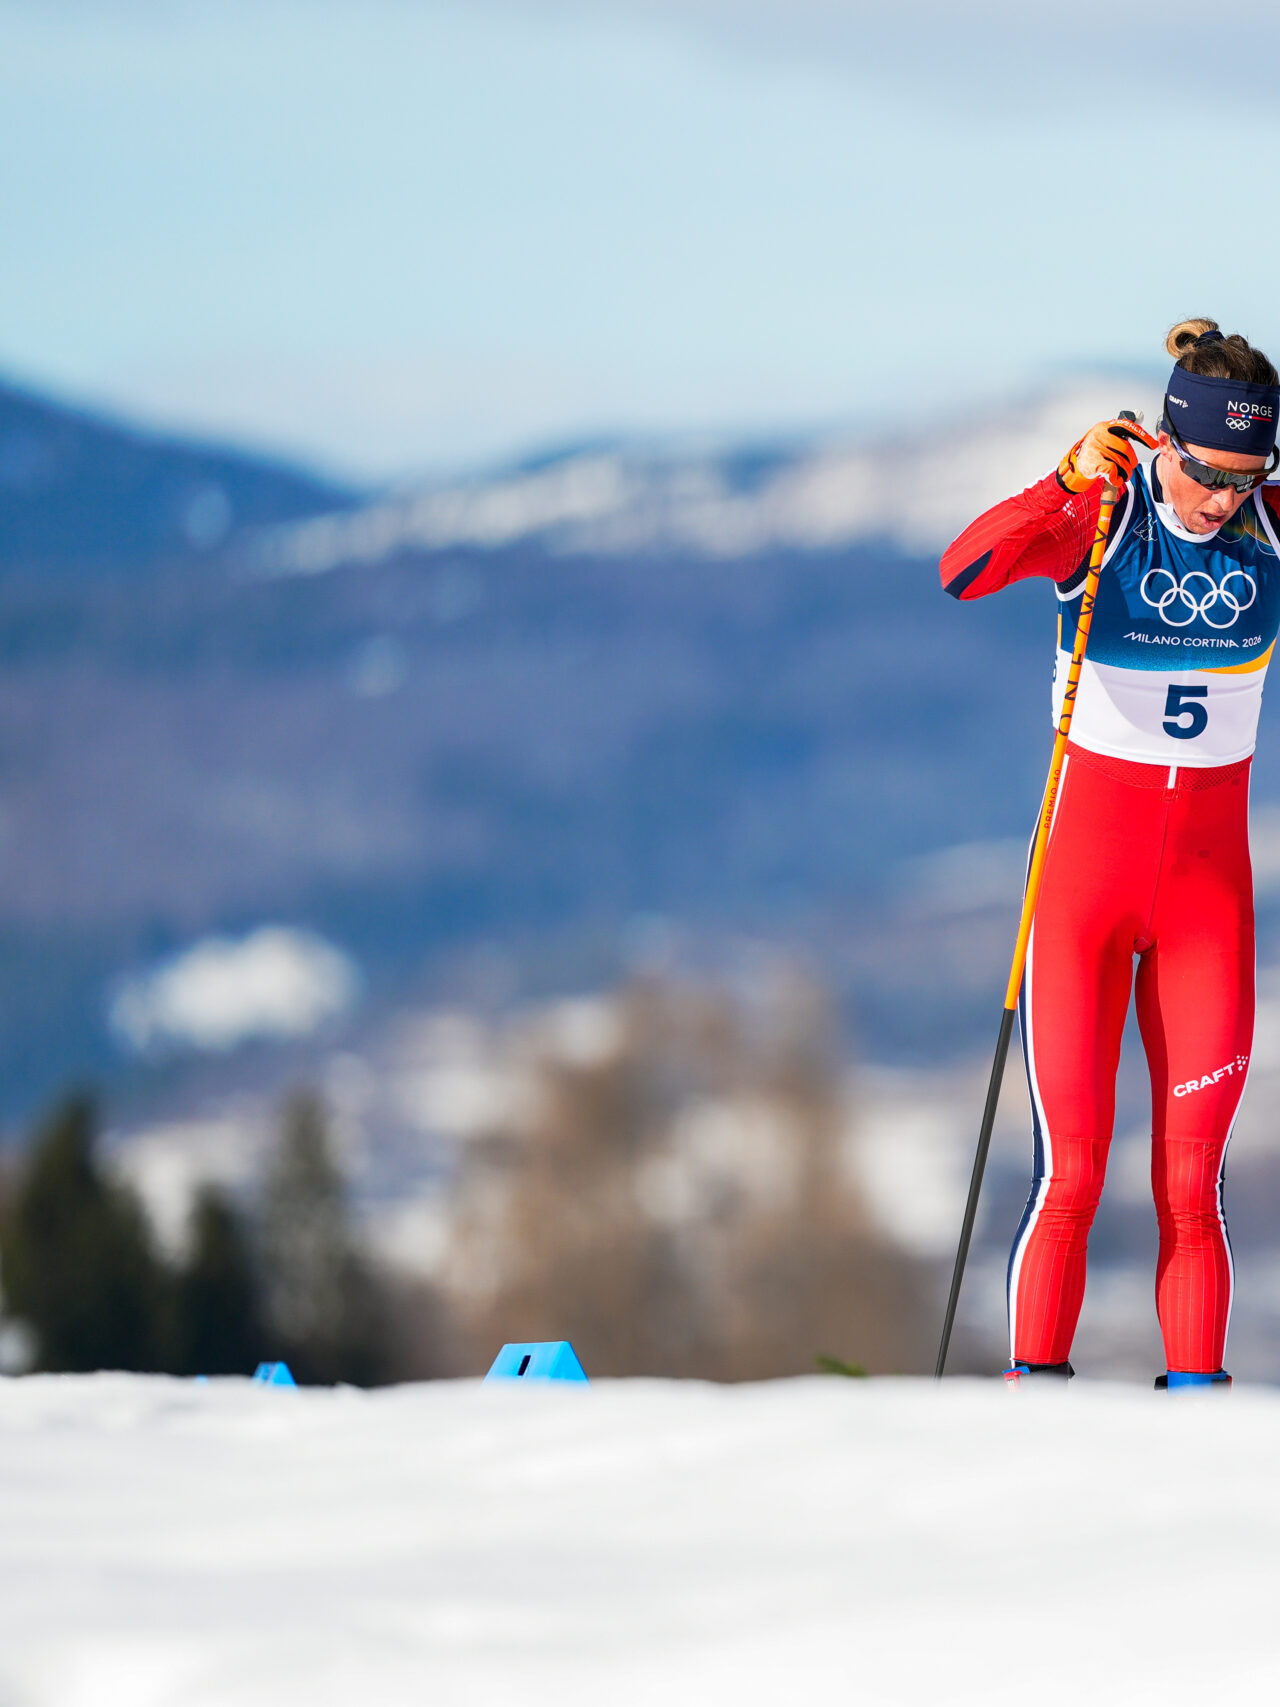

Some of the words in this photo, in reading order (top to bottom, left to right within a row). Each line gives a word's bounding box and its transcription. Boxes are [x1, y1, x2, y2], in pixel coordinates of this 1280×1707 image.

[1227, 400, 1273, 418] NORGE
[1122, 631, 1181, 646] MILANO
[1183, 636, 1240, 648] CORTINA
[1242, 634, 1262, 648] 2026
[1162, 683, 1209, 740] 5
[1043, 787, 1058, 829] PREMIO
[1053, 769, 1061, 782] 40
[1173, 1061, 1236, 1098] CRAFT
